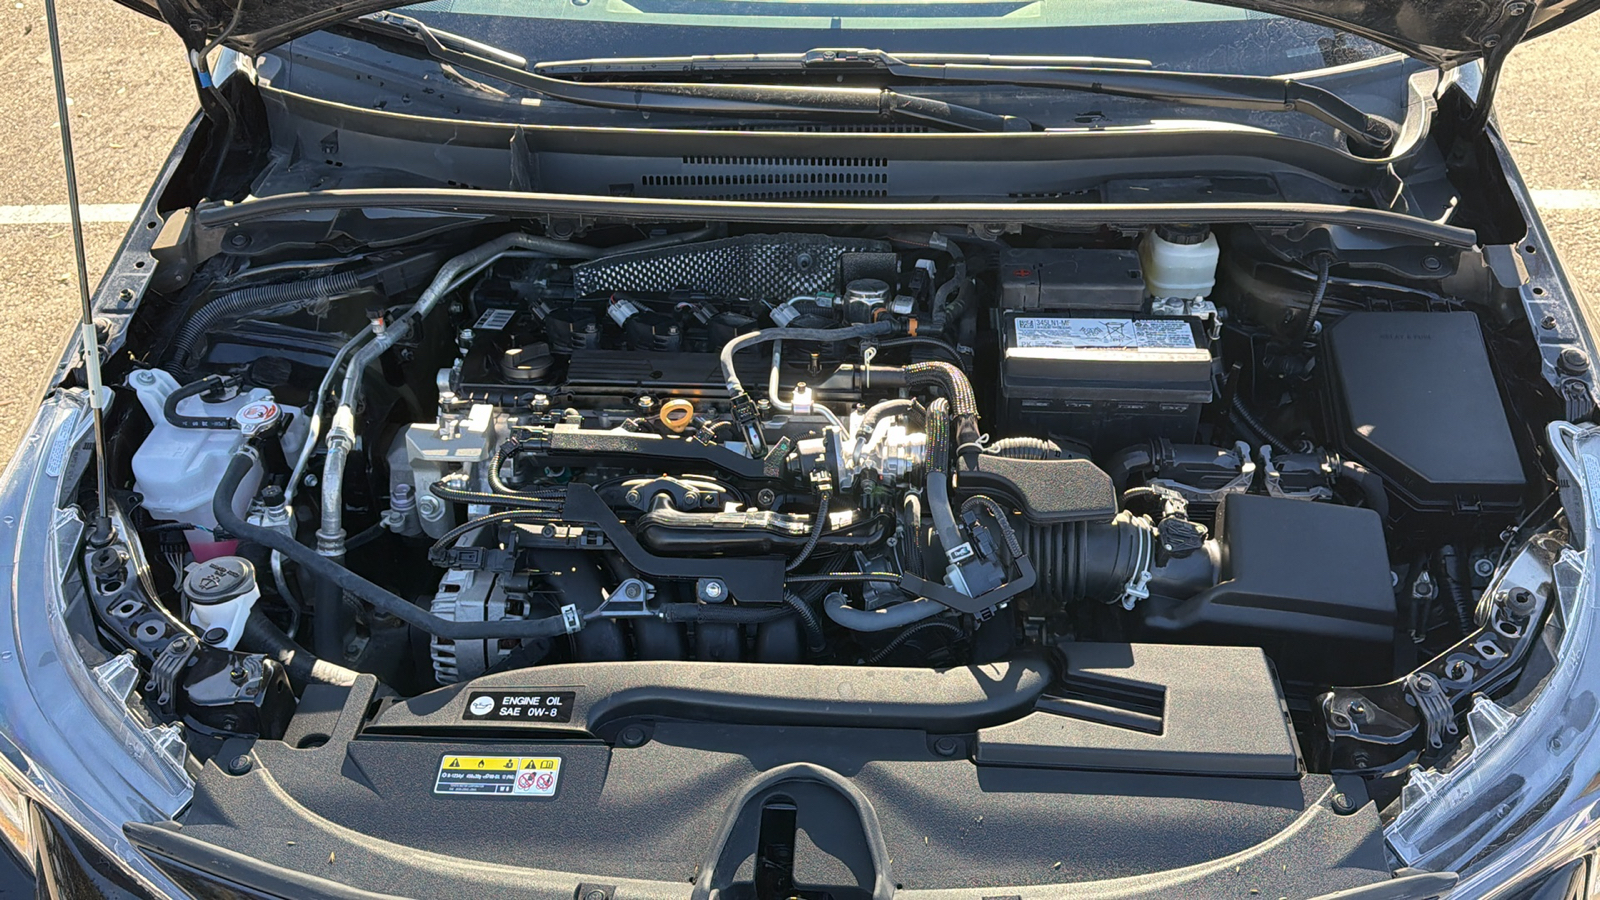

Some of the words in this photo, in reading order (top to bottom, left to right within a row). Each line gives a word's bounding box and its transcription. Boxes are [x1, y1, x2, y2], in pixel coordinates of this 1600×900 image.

[502, 696, 540, 706] ENGINE
[546, 697, 563, 706] OIL
[498, 707, 521, 716] SAE
[527, 708, 558, 717] 0W-8
